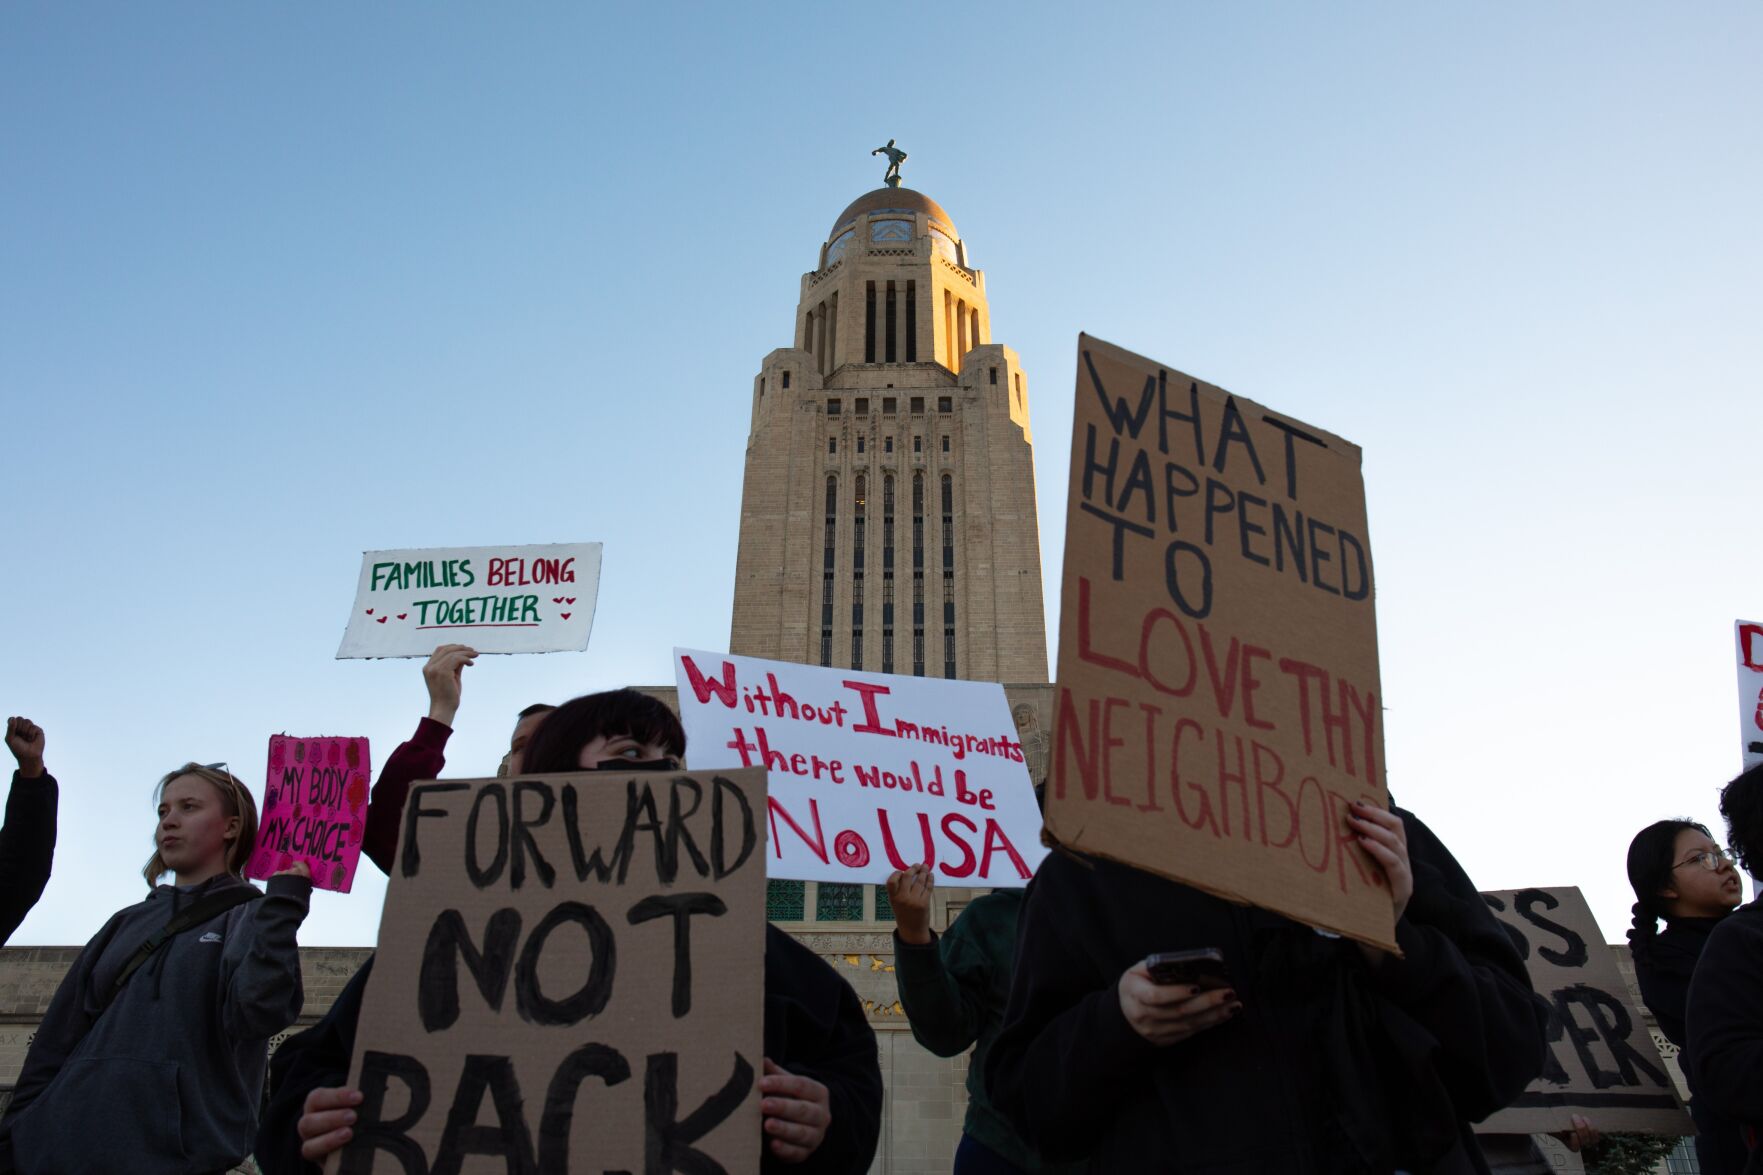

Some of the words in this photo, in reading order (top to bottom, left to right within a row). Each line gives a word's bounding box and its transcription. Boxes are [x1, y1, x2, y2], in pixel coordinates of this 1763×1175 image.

[1083, 350, 1328, 501] WHAT
[1080, 502, 1212, 619] TO
[1082, 422, 1370, 601] HAPPENED
[371, 559, 475, 591] FAMILIES
[487, 557, 576, 587] BELONG
[413, 594, 542, 625] TOGETHER
[681, 655, 848, 727] Without
[842, 680, 1024, 763] Immigrants
[1078, 575, 1276, 730] LOVE
[1278, 656, 1377, 788] THY
[279, 767, 304, 804] MY
[308, 766, 350, 811] BODY
[727, 726, 845, 784] there
[853, 760, 945, 797] would
[954, 769, 996, 811] be
[261, 816, 290, 852] MY
[291, 816, 351, 862] CHOICE
[401, 775, 757, 890] FORWARD
[768, 795, 870, 868] No
[876, 807, 1034, 880] USA
[418, 892, 728, 1033] NOT
[337, 1042, 755, 1175] BACK
